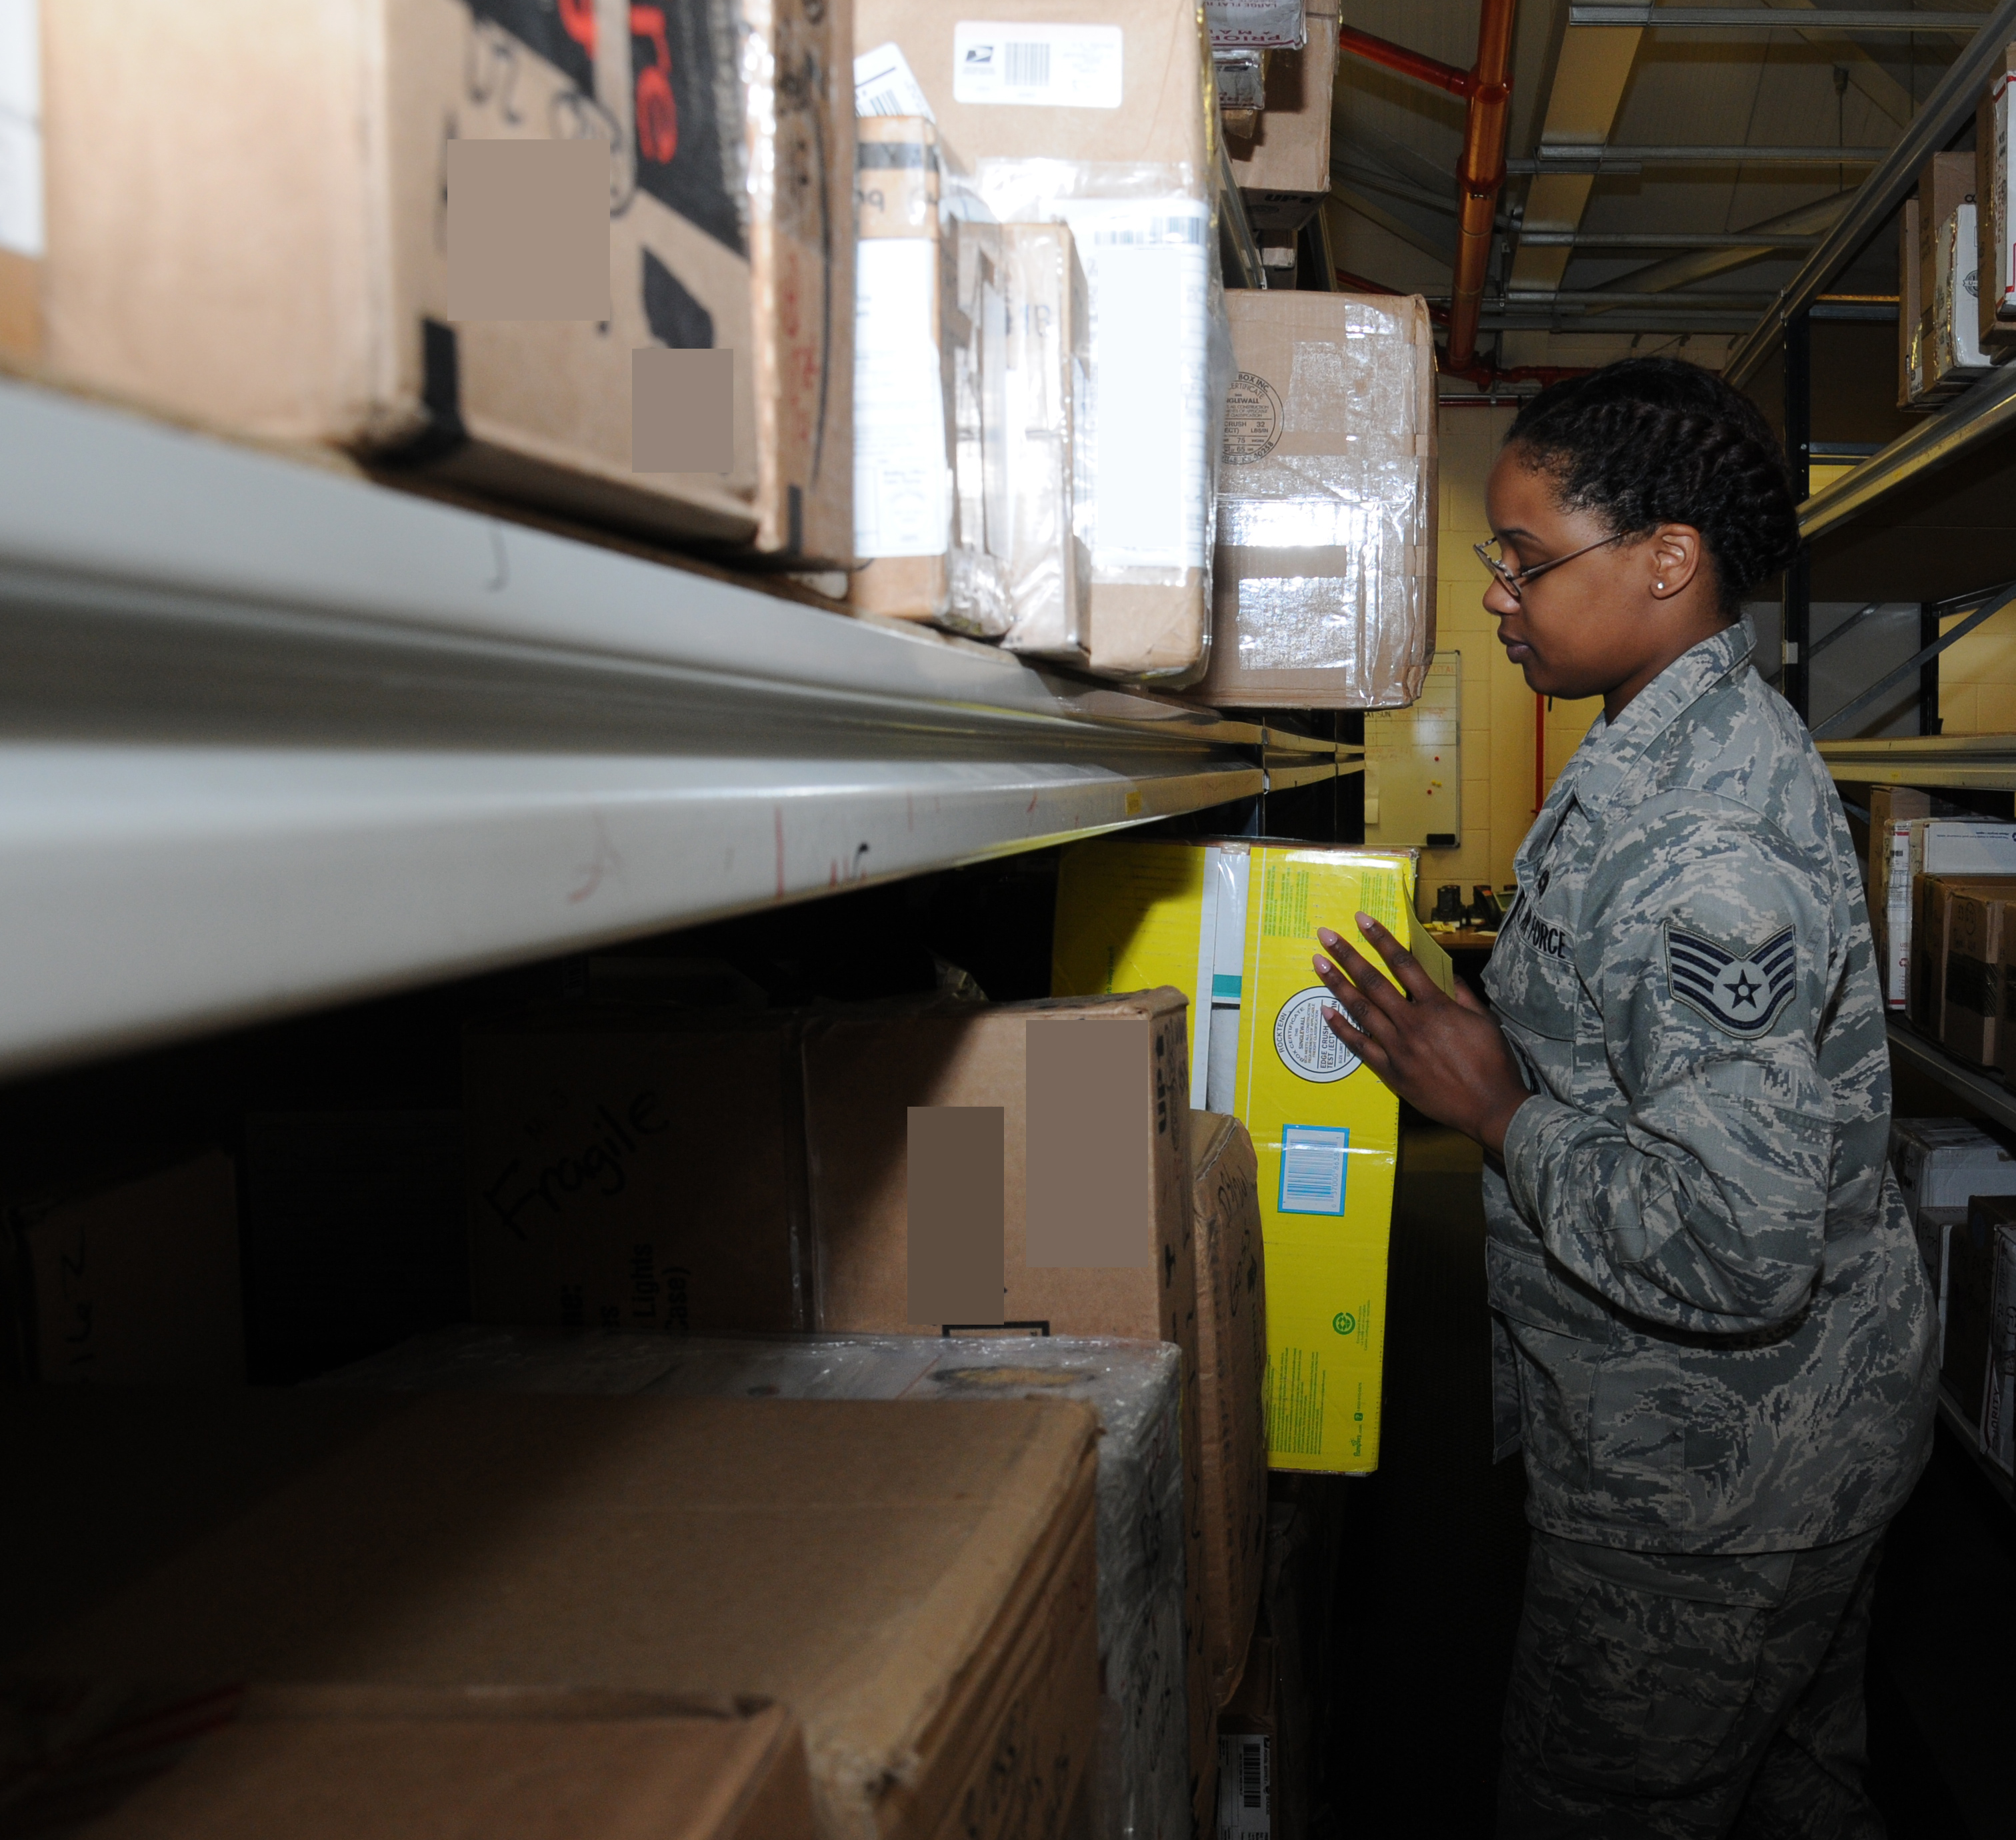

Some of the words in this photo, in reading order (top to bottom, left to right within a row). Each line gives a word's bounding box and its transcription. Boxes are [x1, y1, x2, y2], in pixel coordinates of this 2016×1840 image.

[1238, 374, 1255, 383] BOX
[1276, 1011, 1288, 1053] ROCKTENN
[1287, 1005, 1305, 1048] CERTIFICATE
[1293, 1049, 1305, 1062] BOX
[483, 1089, 669, 1242] Fragile
[629, 1243, 660, 1318] Lights
